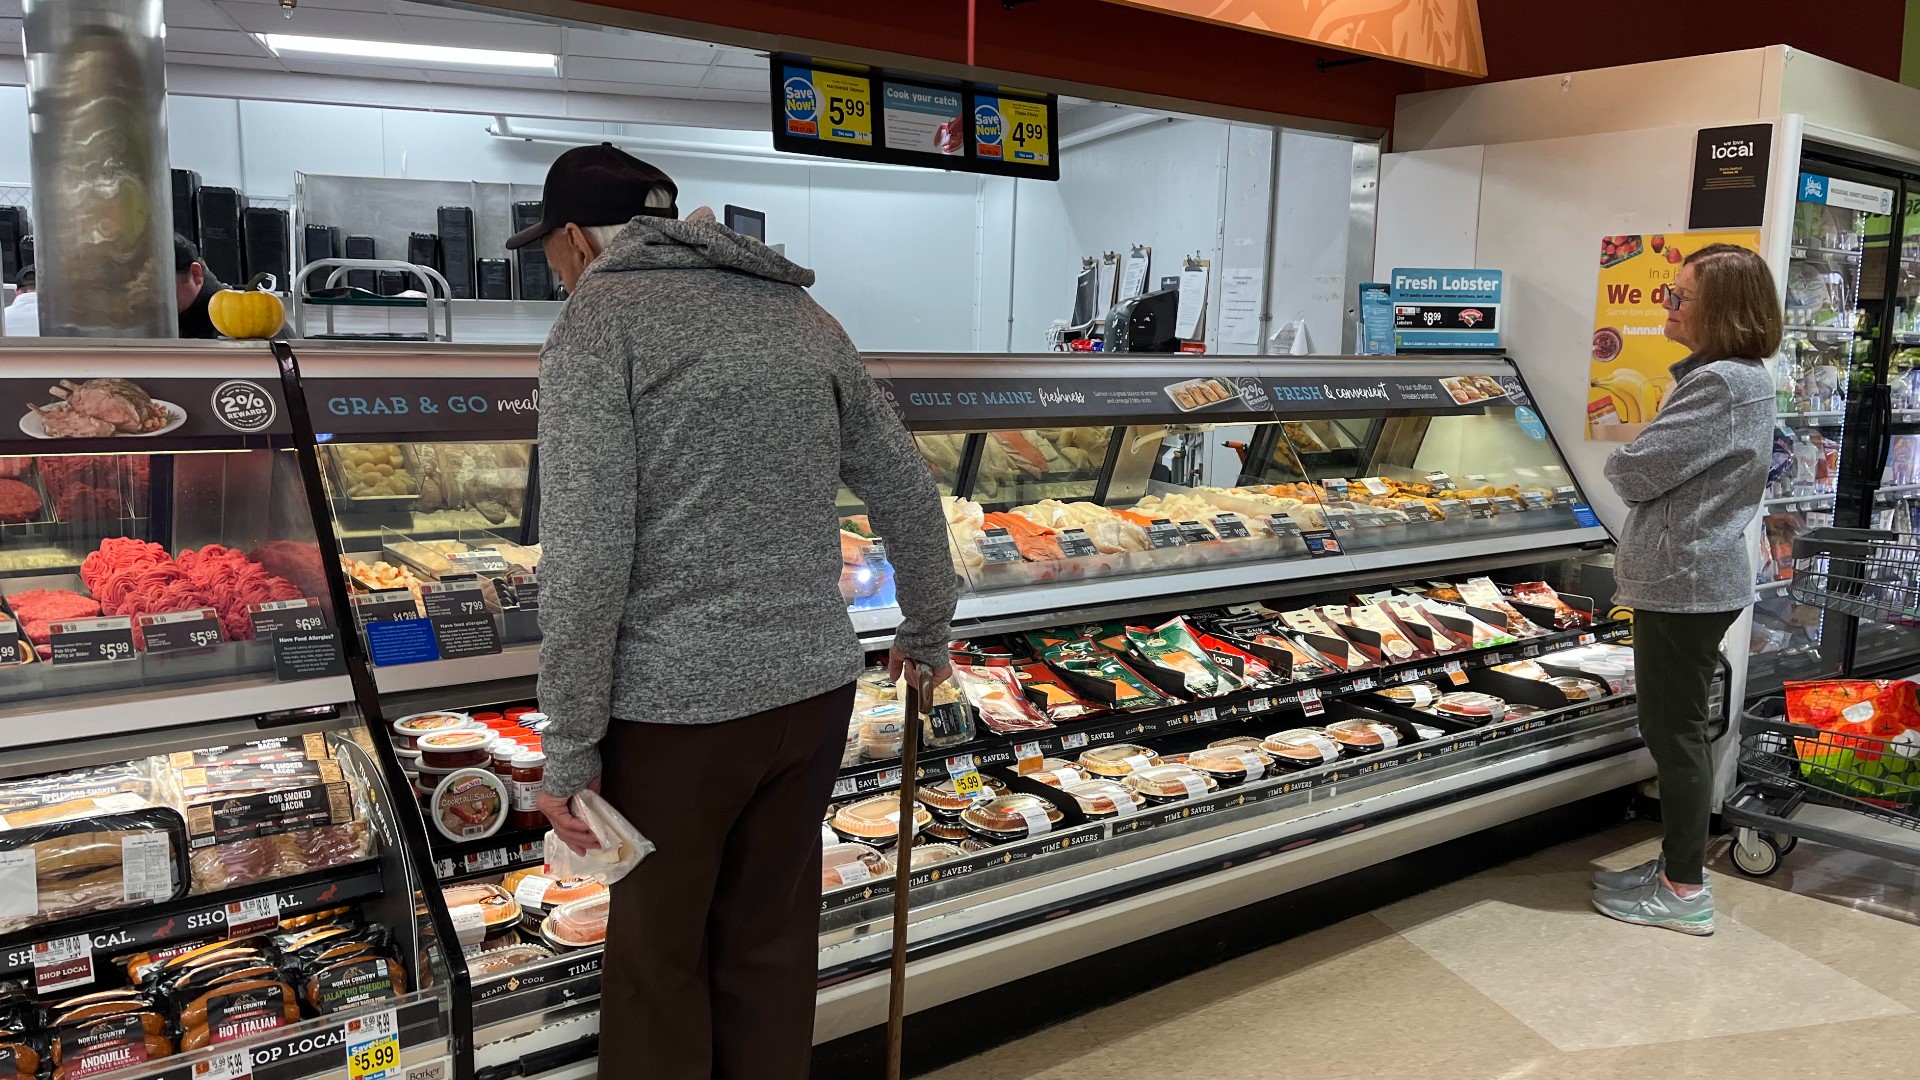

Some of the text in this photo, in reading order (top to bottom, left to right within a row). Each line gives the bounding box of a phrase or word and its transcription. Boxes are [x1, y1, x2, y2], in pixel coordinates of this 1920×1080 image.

[785, 86, 814, 98] Save
[886, 88, 958, 106] Cook your catch
[786, 98, 816, 110] Now!
[976, 114, 998, 124] Save
[976, 125, 1000, 136] Now!
[1712, 142, 1754, 159] local
[1650, 268, 1670, 279] In a
[1396, 276, 1498, 290] Fresh Lobster
[1607, 284, 1642, 304] We
[1623, 325, 1664, 335] hannaf
[1242, 383, 1264, 400] 2%
[1273, 382, 1390, 401] FRESH & convenient
[1506, 380, 1522, 394] 2%
[221, 393, 264, 412] 2%
[328, 389, 539, 415] GRAB & GO meal
[910, 392, 952, 406] GULF
[957, 392, 978, 405] OF
[981, 391, 1036, 404] MAINE
[1038, 387, 1084, 407] freshness
[227, 408, 267, 420] REWARDS
[1500, 586, 1513, 595] we
[308, 634, 334, 642] Allergies?
[1212, 654, 1233, 666] local
[1278, 696, 1299, 704] SAVERS
[1166, 717, 1182, 727] TIME
[1513, 720, 1546, 734] TIME SAVERS
[1090, 732, 1114, 741] SAVERS
[258, 742, 282, 750] BACON
[1440, 740, 1476, 754] TIME SAVERS
[982, 752, 1010, 763] SAVERS
[1358, 760, 1398, 776] TIME SAVERS
[858, 778, 878, 788] SAVE
[956, 776, 979, 790] $5.99
[1268, 780, 1312, 798] TIME SAVERS
[268, 790, 312, 804] COB SMOKED
[442, 791, 497, 806] Cocktail Sauce
[214, 805, 250, 816] NORTH COUNTRY
[280, 800, 304, 812] BACON
[1164, 804, 1214, 823] TIME SAVERS
[1116, 820, 1152, 834] READY COOK
[1042, 833, 1098, 854] TIME SAVERS
[986, 856, 1004, 868] READY
[908, 864, 973, 888] TIME SAVERS
[844, 886, 890, 904] READY COOK
[188, 910, 226, 928] SHO
[8, 952, 34, 967] SH
[39, 964, 88, 980] SHOP LOCAL
[568, 960, 598, 977] TIME
[332, 972, 376, 988] NORTH COUNTRY
[358, 980, 391, 994] CHEDDAR
[481, 976, 544, 999] READY COOK
[346, 992, 370, 1004] SAUSAGE
[224, 1000, 267, 1014] NORTH COUNTRY
[218, 1016, 277, 1038] HOT ITALIAN
[78, 1028, 126, 1045] NORTH COUNTRY
[88, 1040, 117, 1050] ORIGINAL
[250, 1030, 346, 1066] HOP LOCAL
[81, 1048, 130, 1070] ANDOUILLE
[354, 1046, 394, 1070] $5.99
[72, 1056, 140, 1076] CAJUN STYLE SAUSAGE
[410, 1066, 440, 1080] Barker
